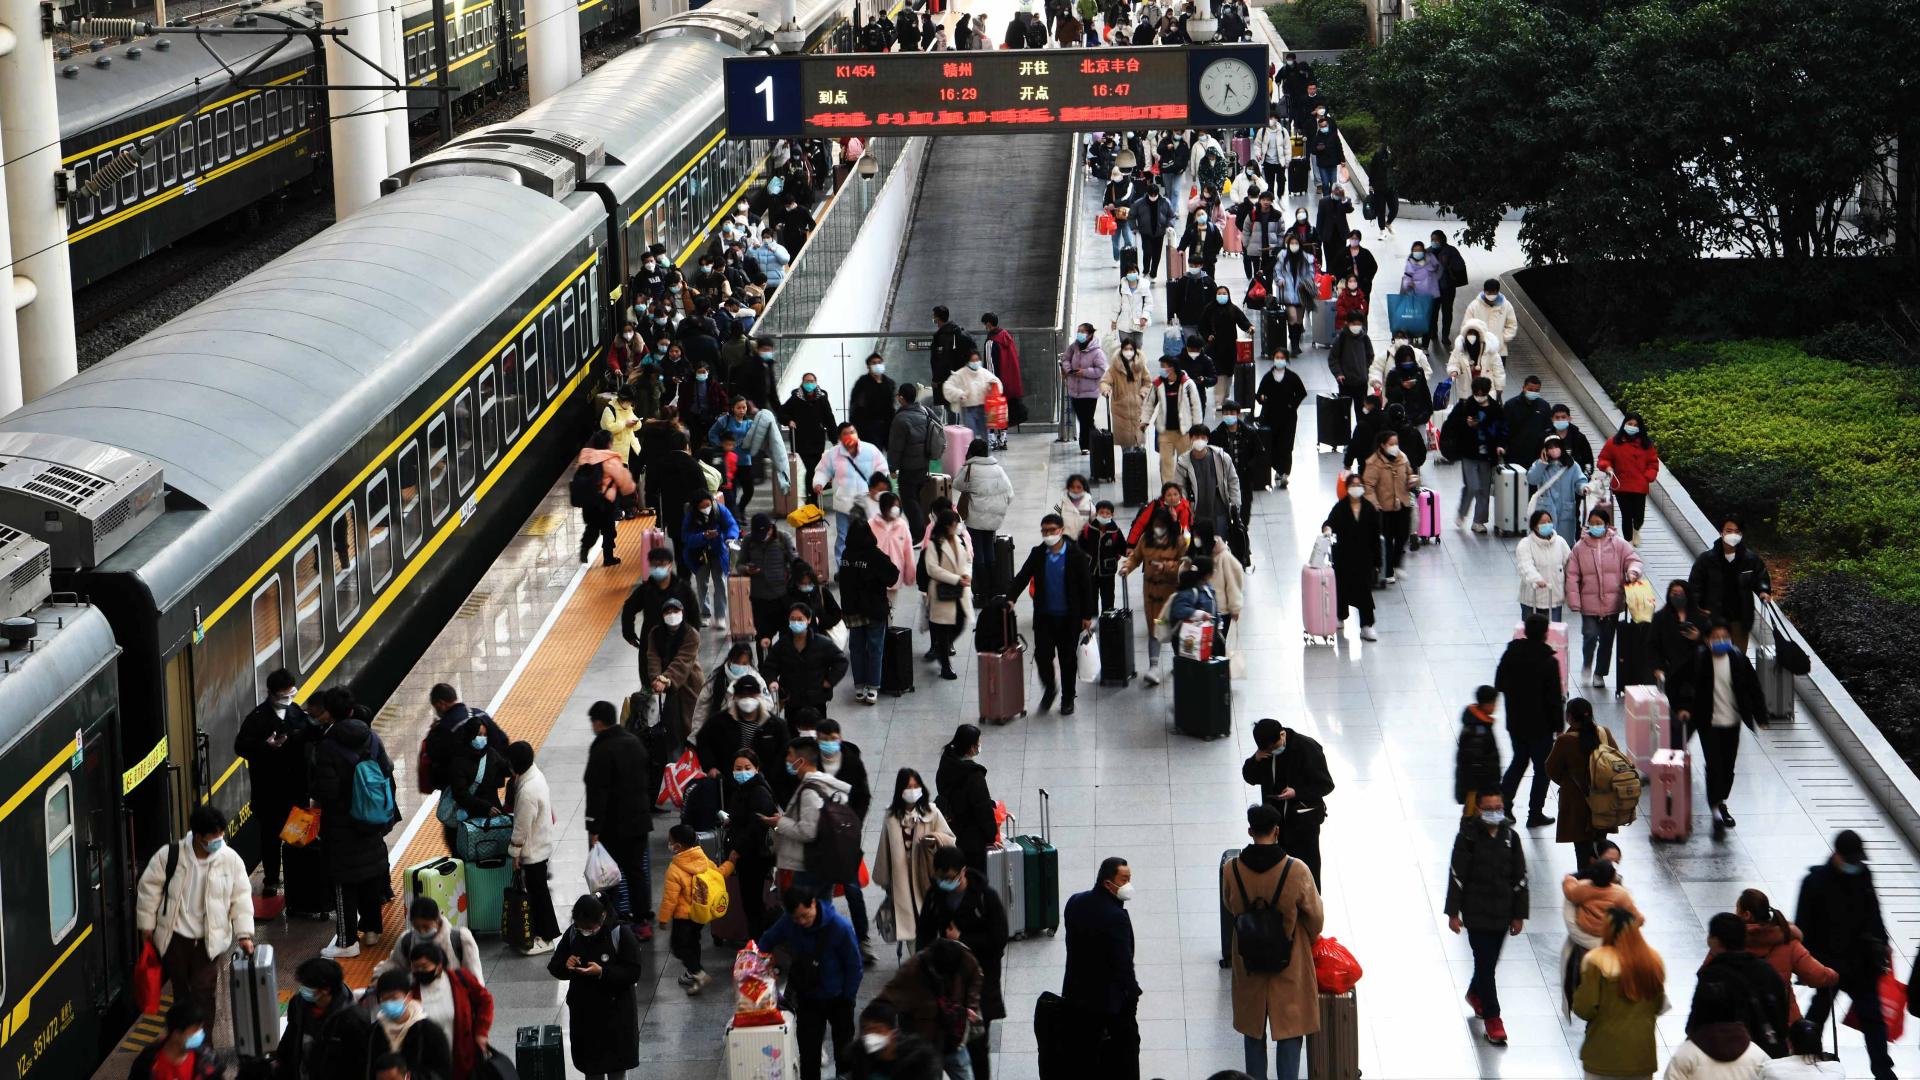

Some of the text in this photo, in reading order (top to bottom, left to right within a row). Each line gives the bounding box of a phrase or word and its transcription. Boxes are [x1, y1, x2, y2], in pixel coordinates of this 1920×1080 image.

[836, 65, 876, 78] K1454
[1019, 60, 1049, 76] 开往
[1080, 58, 1140, 74] 北京丰台
[754, 75, 775, 122] 1
[818, 84, 1131, 105] 到点 16:29 开点 16:47
[33, 1016, 59, 1060] 351472
